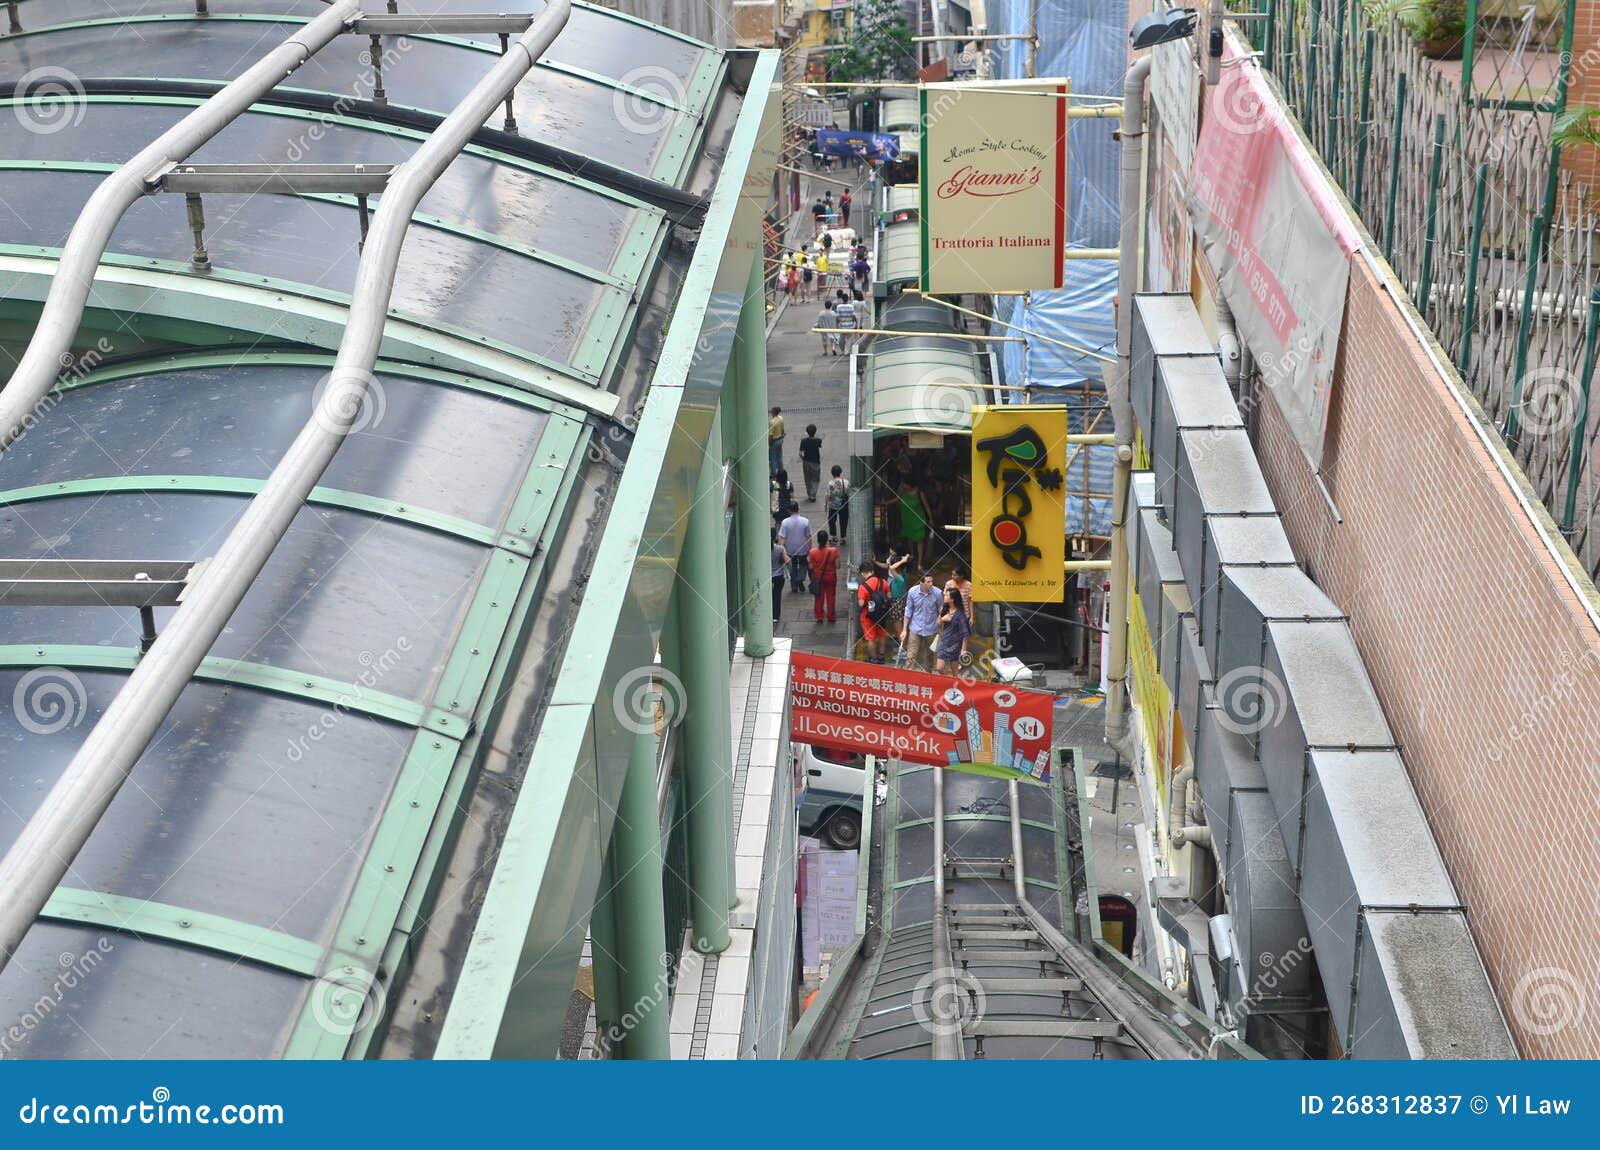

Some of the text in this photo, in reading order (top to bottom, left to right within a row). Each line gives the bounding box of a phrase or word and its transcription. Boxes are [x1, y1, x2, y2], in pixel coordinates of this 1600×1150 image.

[943, 139, 1047, 162] Home Style Cooking
[937, 165, 1042, 199] Gianni's
[932, 236, 1051, 249] Trattoria Italiana
[815, 700, 870, 718] AROUND
[873, 710, 912, 725] SOHO
[828, 687, 846, 700] TO
[849, 691, 930, 714] EVERYTHING
